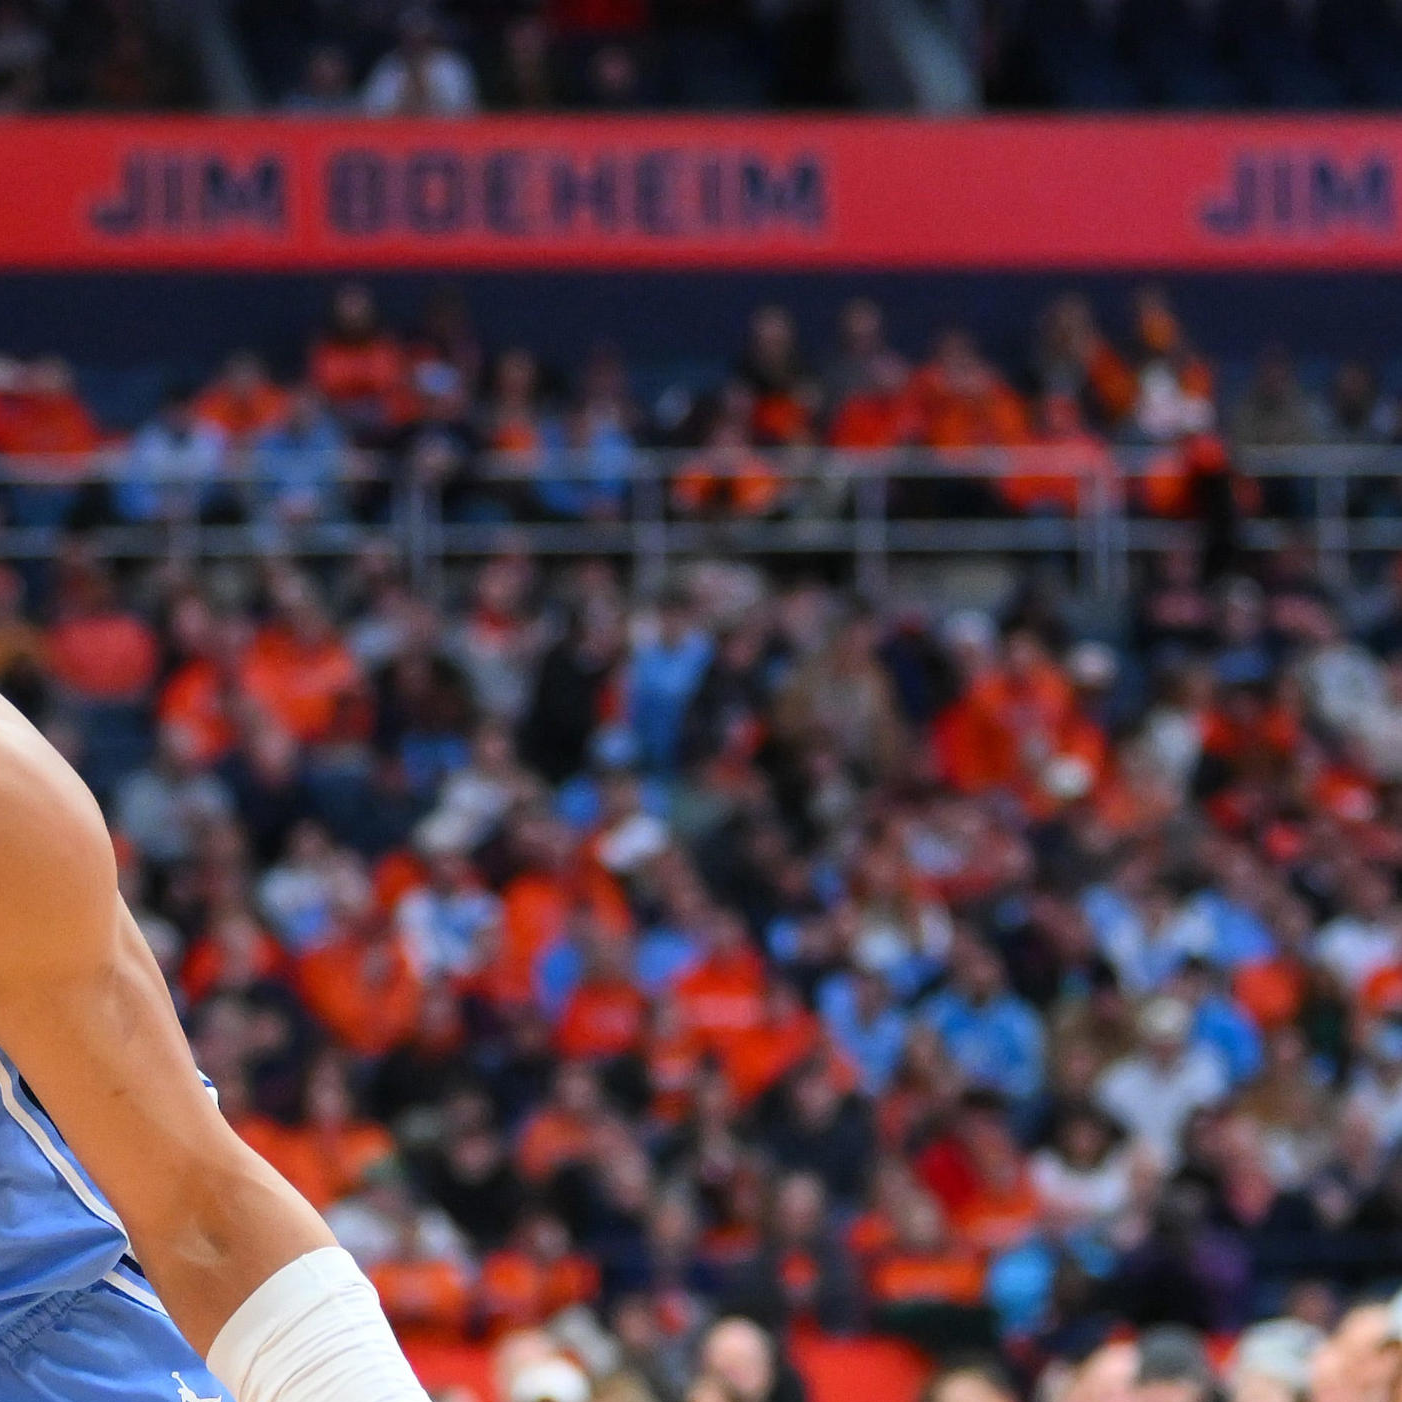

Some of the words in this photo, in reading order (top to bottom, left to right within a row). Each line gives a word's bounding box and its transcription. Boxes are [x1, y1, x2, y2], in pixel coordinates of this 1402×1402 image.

[88, 146, 286, 238] JIM
[322, 146, 828, 238] BOEHEIM
[1199, 147, 1394, 238] JIM
